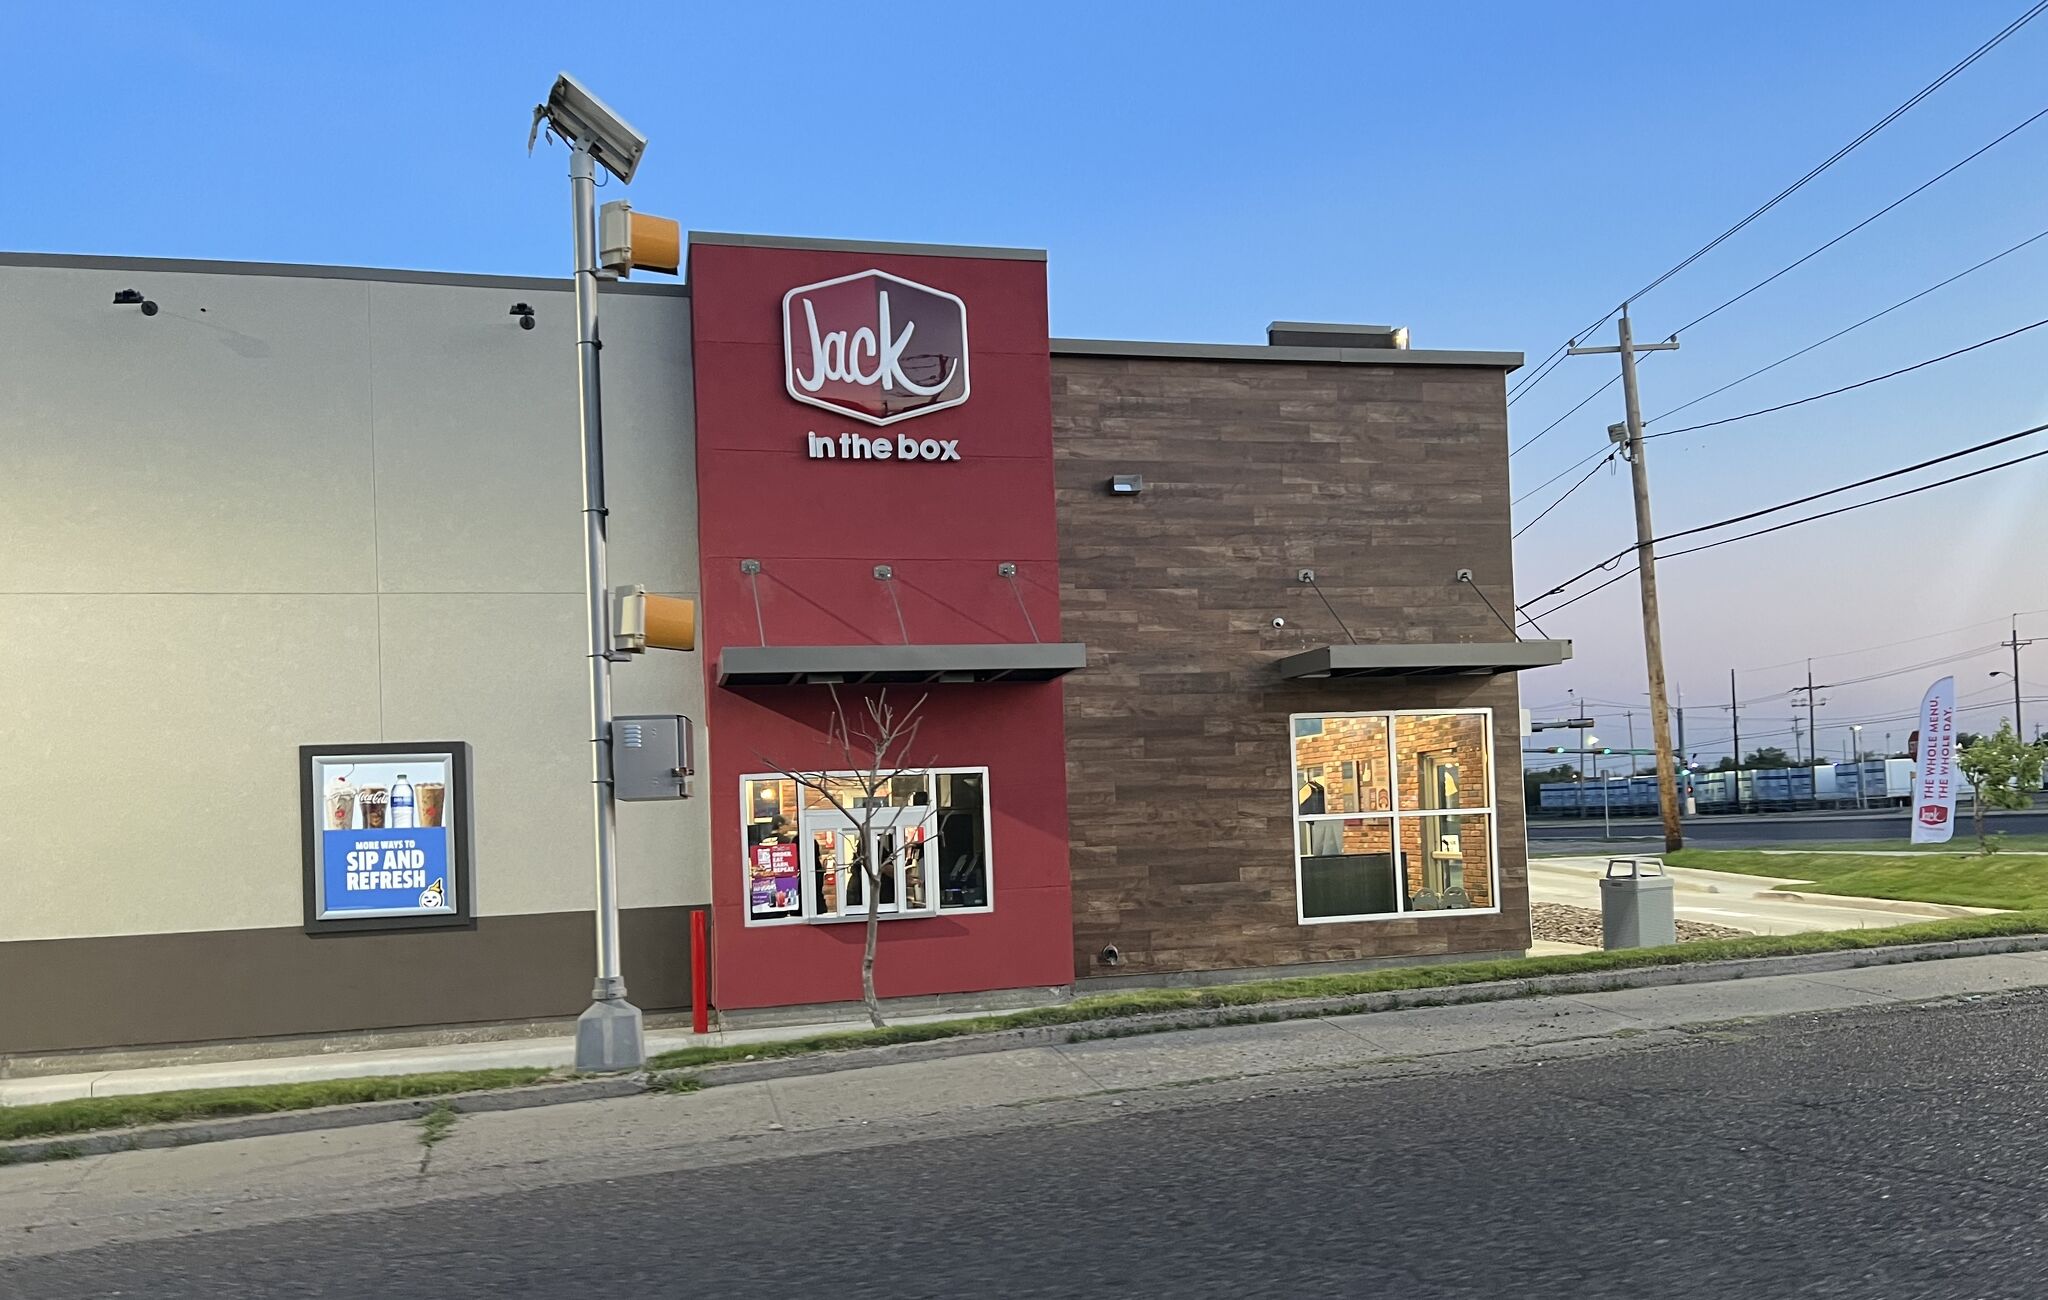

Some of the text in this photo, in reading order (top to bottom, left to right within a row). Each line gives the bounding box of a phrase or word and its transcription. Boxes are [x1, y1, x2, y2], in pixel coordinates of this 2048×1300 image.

[796, 290, 958, 396] Jack
[808, 431, 961, 461] in the box
[1924, 696, 1940, 800] THE WHOLE MENU,
[1938, 706, 1952, 800] THE WHOLE DAY.
[355, 839, 416, 850] MORE WAYS TO
[346, 849, 425, 871] SIP AND
[346, 869, 426, 891] REFRESH
